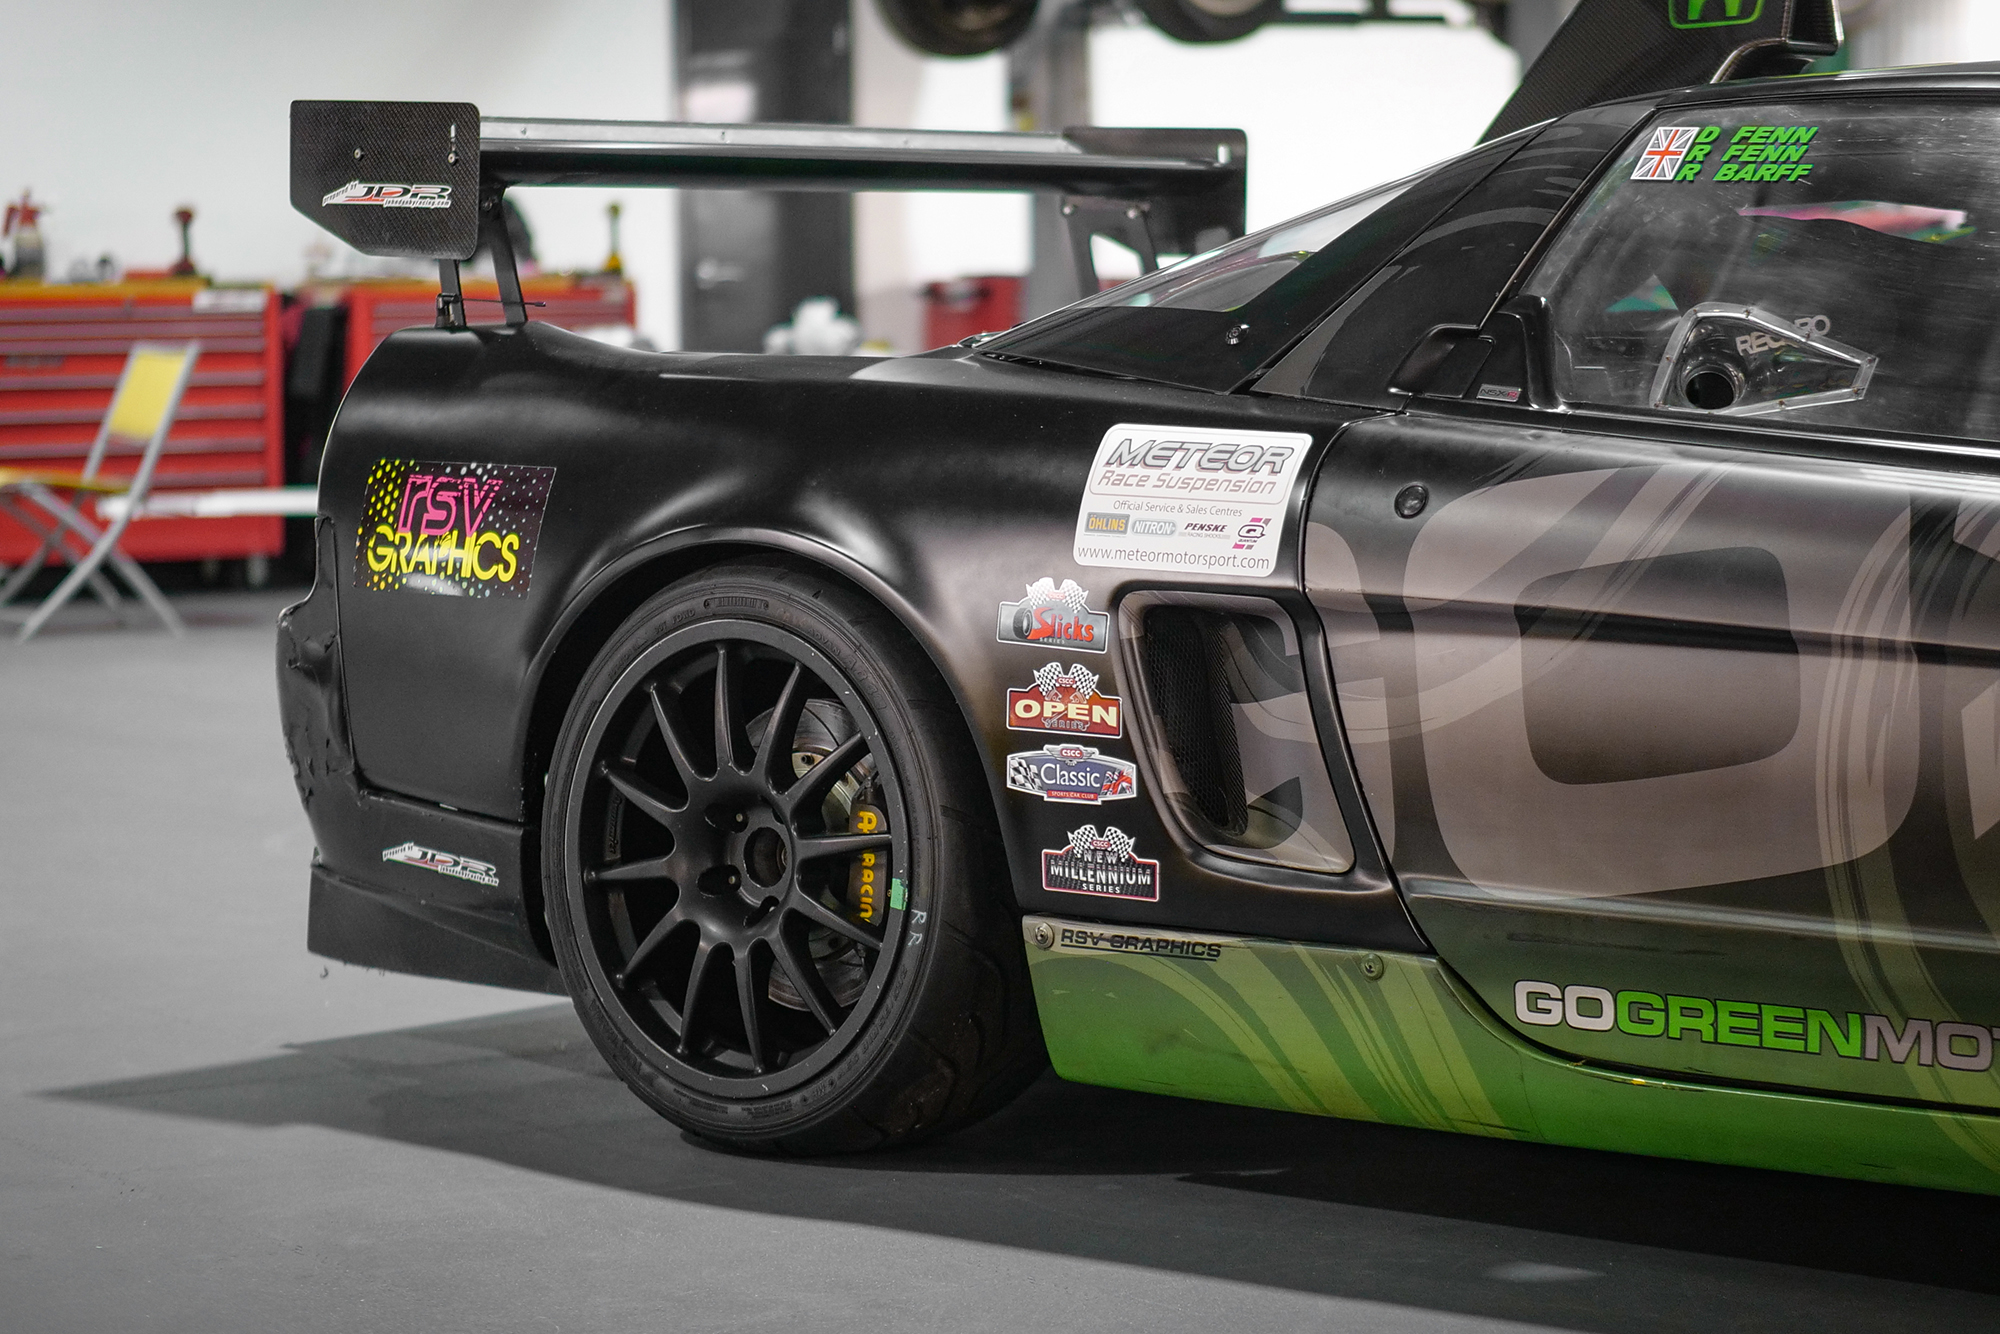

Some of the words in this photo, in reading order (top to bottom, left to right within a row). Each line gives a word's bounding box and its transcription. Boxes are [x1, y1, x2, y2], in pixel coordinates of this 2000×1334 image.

[1695, 126, 1721, 143] D
[1730, 126, 1819, 144] FENN
[1684, 144, 1713, 161] R
[1720, 145, 1808, 162] FENN
[1674, 163, 1702, 181] R
[1712, 163, 1814, 181] BARFF
[1104, 438, 1295, 475] METEOR
[1097, 470, 1148, 488] Race
[1151, 473, 1277, 495] Suspension
[1113, 500, 1143, 512] Official
[1145, 503, 1175, 513] Service
[1177, 504, 1184, 513] &
[1186, 506, 1208, 515] Sales
[1210, 507, 1243, 517] Centres
[1133, 520, 1171, 534] NITRON
[1184, 522, 1228, 533] PENSKE
[367, 524, 520, 583] GRAPHICS
[1077, 547, 1270, 570] www.meteormotorsport.com
[1026, 607, 1095, 642] Slicks
[1058, 677, 1075, 685] CSCC
[1015, 699, 1117, 728] OPEN
[1046, 719, 1084, 731] SERIES
[1062, 748, 1081, 757] CSCC
[1040, 762, 1101, 788] Classic
[1092, 840, 1111, 848] CSCC
[1083, 850, 1119, 865] NEW
[1050, 860, 1151, 885] MILLENNIUM
[1082, 883, 1121, 893] SERIES
[1060, 928, 1102, 946] RSV
[1109, 934, 1221, 957] GRAPHICS
[1513, 979, 2000, 1073] GOGREENMO
